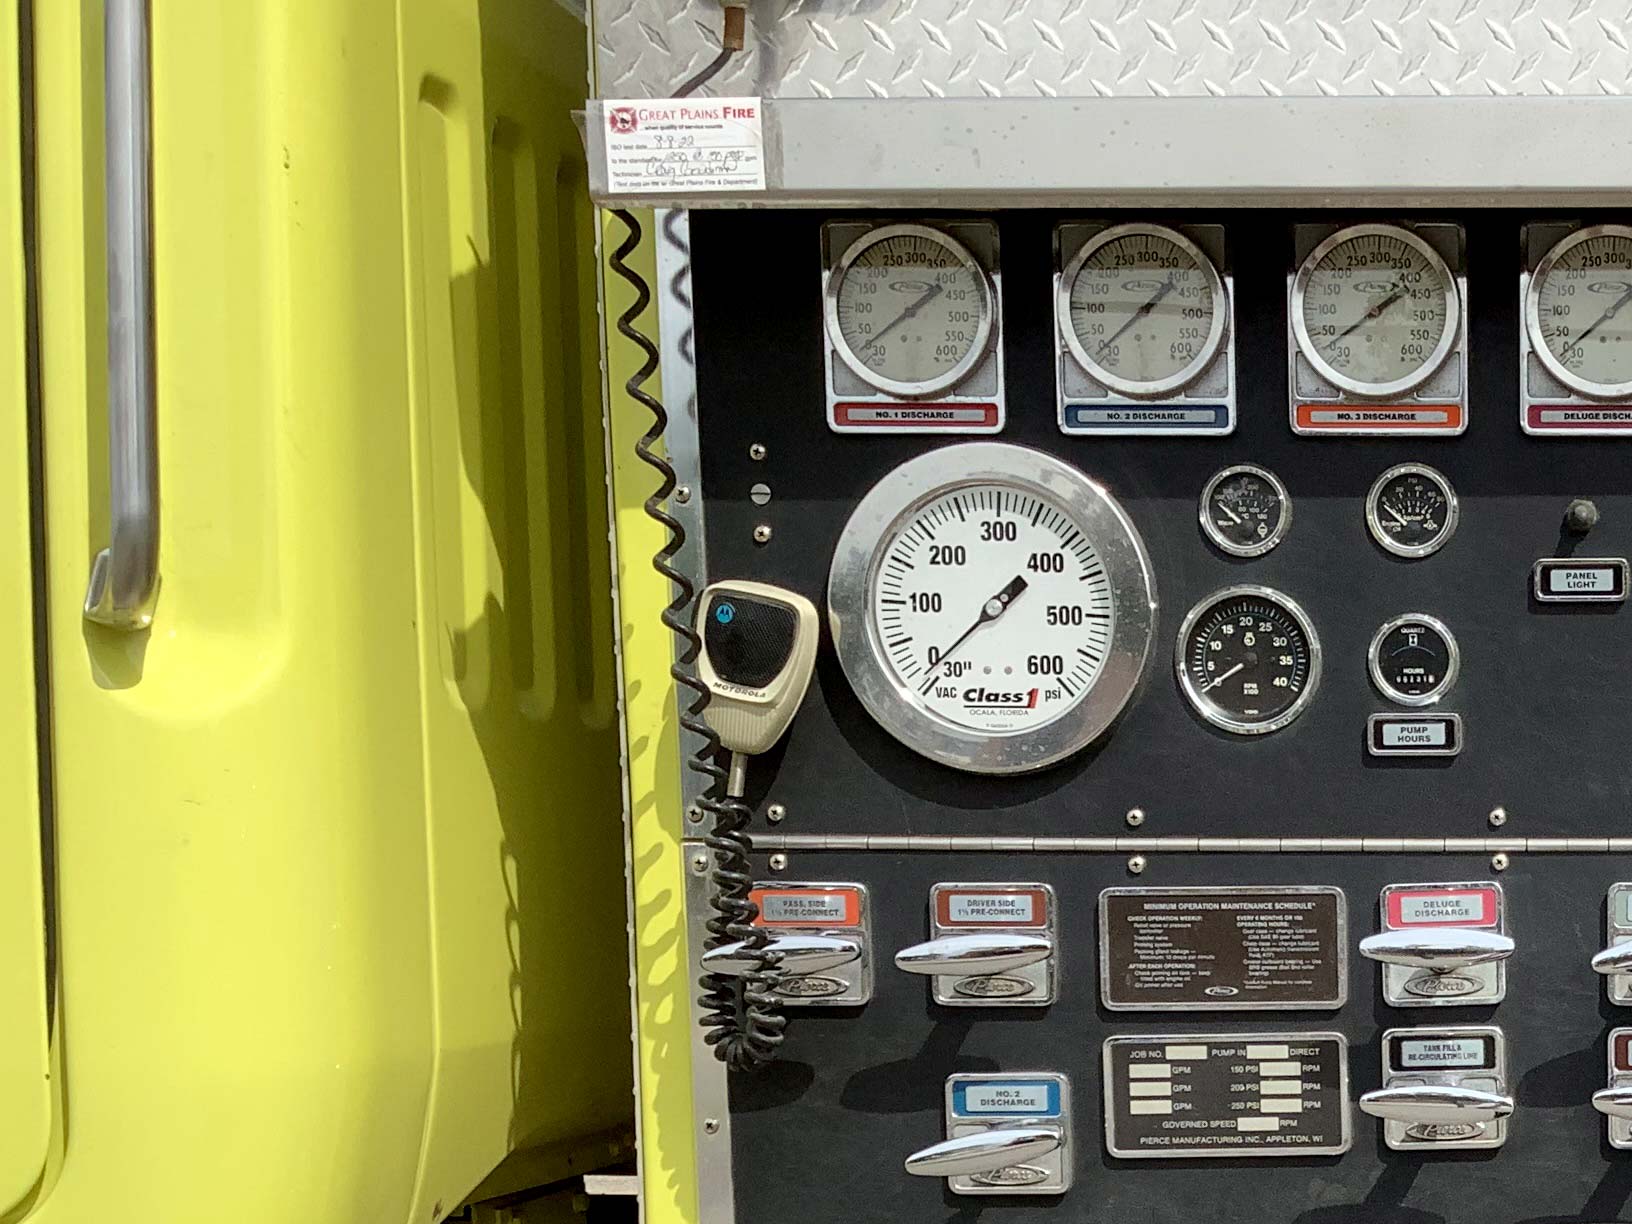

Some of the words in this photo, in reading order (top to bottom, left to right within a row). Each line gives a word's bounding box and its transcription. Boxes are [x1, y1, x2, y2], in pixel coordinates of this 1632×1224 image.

[639, 109, 676, 121] GREAT
[681, 108, 719, 120] PLAINS
[723, 107, 756, 120] FIRE
[980, 521, 1017, 541] 300
[929, 545, 966, 565] 200
[1027, 553, 1064, 573] 400
[1565, 572, 1598, 580] PANEL
[1567, 581, 1597, 589] LIGHT
[909, 592, 942, 613] 100
[1046, 606, 1082, 625] 500
[1239, 617, 1253, 626] 20
[1221, 625, 1234, 634] 15
[1259, 622, 1272, 631] 25
[1210, 641, 1222, 650] 10
[1273, 637, 1287, 646] 30
[1027, 655, 1063, 675] 600
[1280, 656, 1293, 665] 35
[1208, 662, 1215, 671] 5
[1273, 677, 1287, 687] 40
[713, 682, 766, 699] MOTOROLA
[935, 687, 957, 698] VAC
[1045, 688, 1061, 702] psi
[969, 709, 998, 717] OCALA,
[1400, 726, 1428, 734] PUMP
[1397, 735, 1431, 743] HOURS
[1221, 902, 1273, 910] MAINTENANCE
[1423, 900, 1461, 908] DELUGE
[970, 908, 1026, 916] PRE-CONNECT
[1415, 908, 1470, 917] DISCHARGE
[1148, 1050, 1164, 1058] NO.
[1211, 1049, 1234, 1057] PUMP
[1289, 1048, 1320, 1056] DIRECT
[1245, 1065, 1258, 1073] PSI
[1302, 1064, 1320, 1072] RPM
[995, 1090, 1013, 1098] NO.
[1173, 1102, 1192, 1110] GPM
[1246, 1101, 1259, 1109] PSI
[1162, 1121, 1208, 1129] GOVERNED
[1210, 1120, 1236, 1128] SPEED
[1280, 1119, 1297, 1127] RPM
[1140, 1136, 1170, 1144] PIERCE
[1172, 1136, 1243, 1144] MANUFACTURING
[1312, 1134, 1323, 1142] WI
